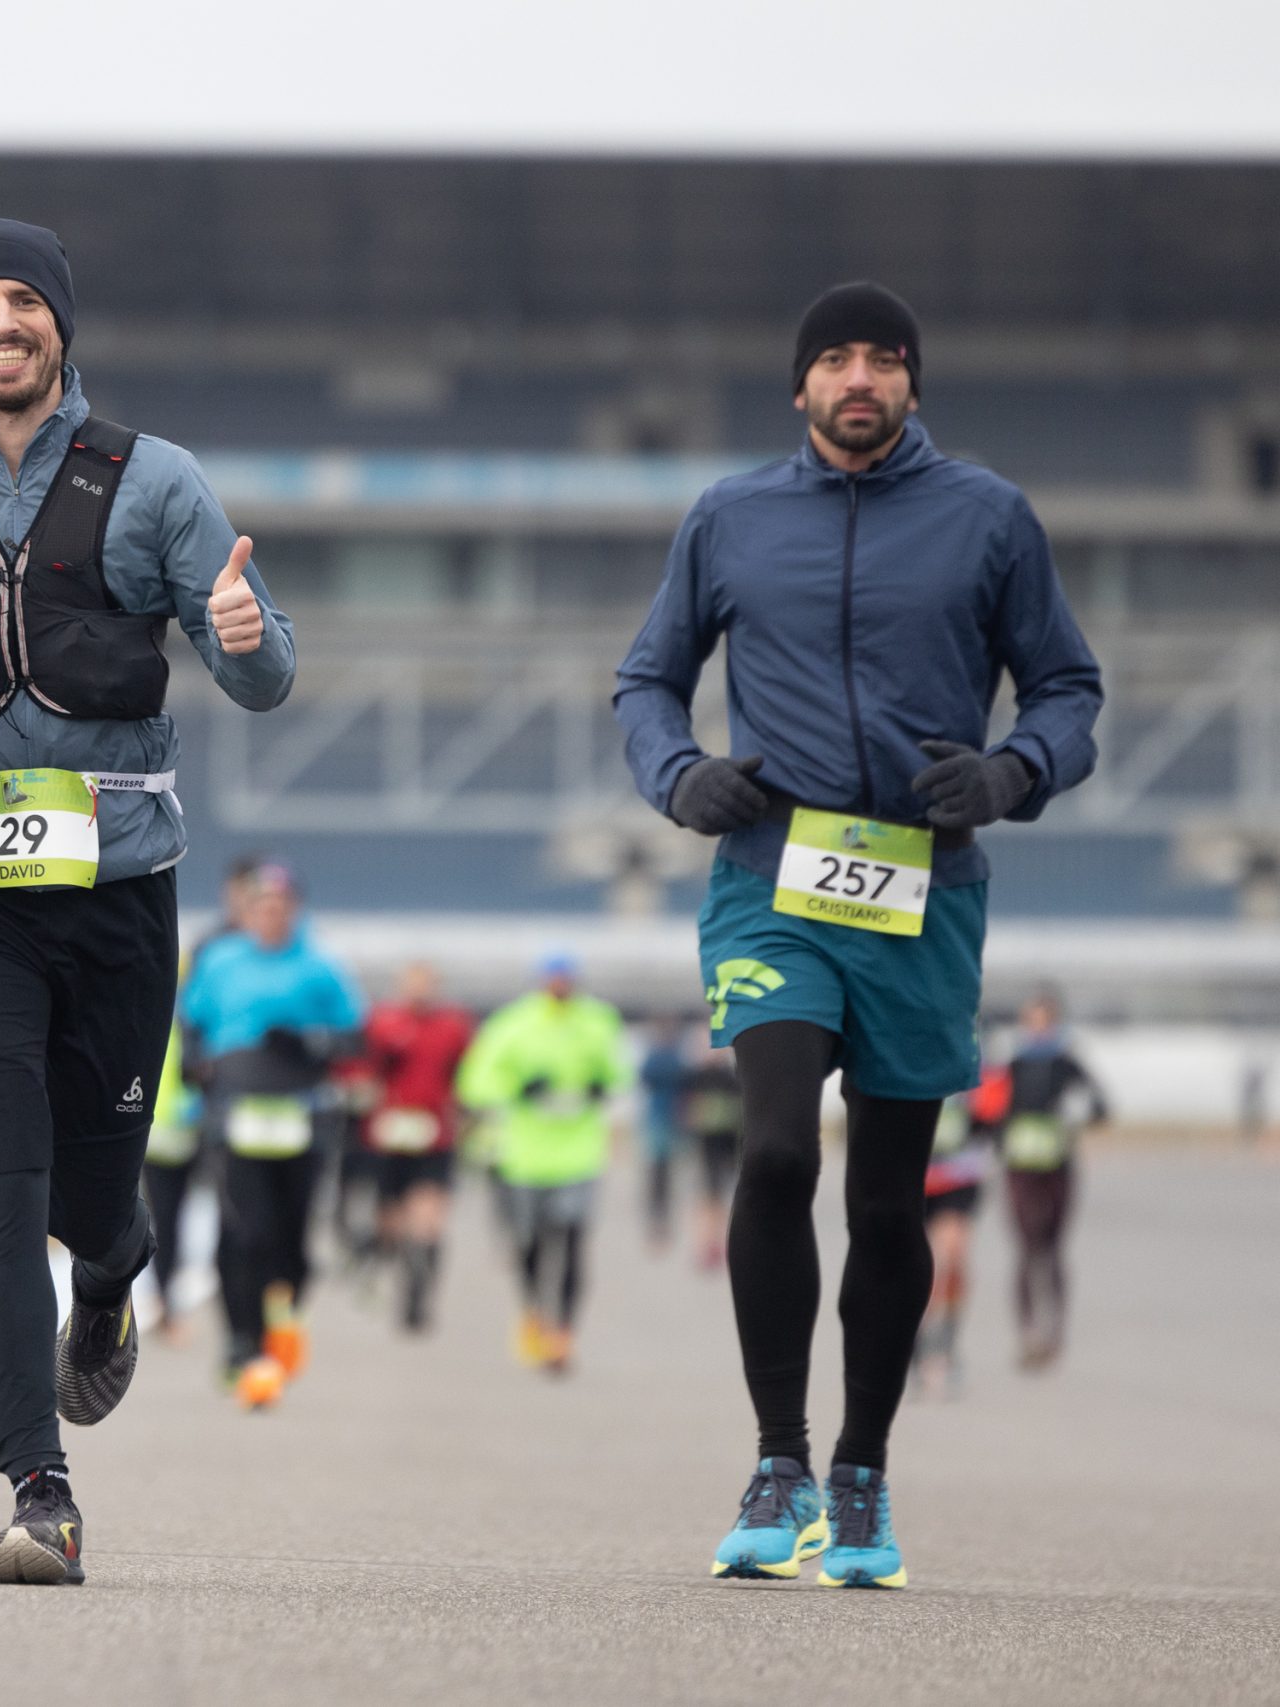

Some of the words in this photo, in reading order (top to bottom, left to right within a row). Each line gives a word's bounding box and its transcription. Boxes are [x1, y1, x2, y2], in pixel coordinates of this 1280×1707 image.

[0, 863, 46, 880] DAVID
[814, 856, 897, 901] 257
[806, 897, 891, 925] CRISTIANO
[116, 1103, 144, 1113] odlo
